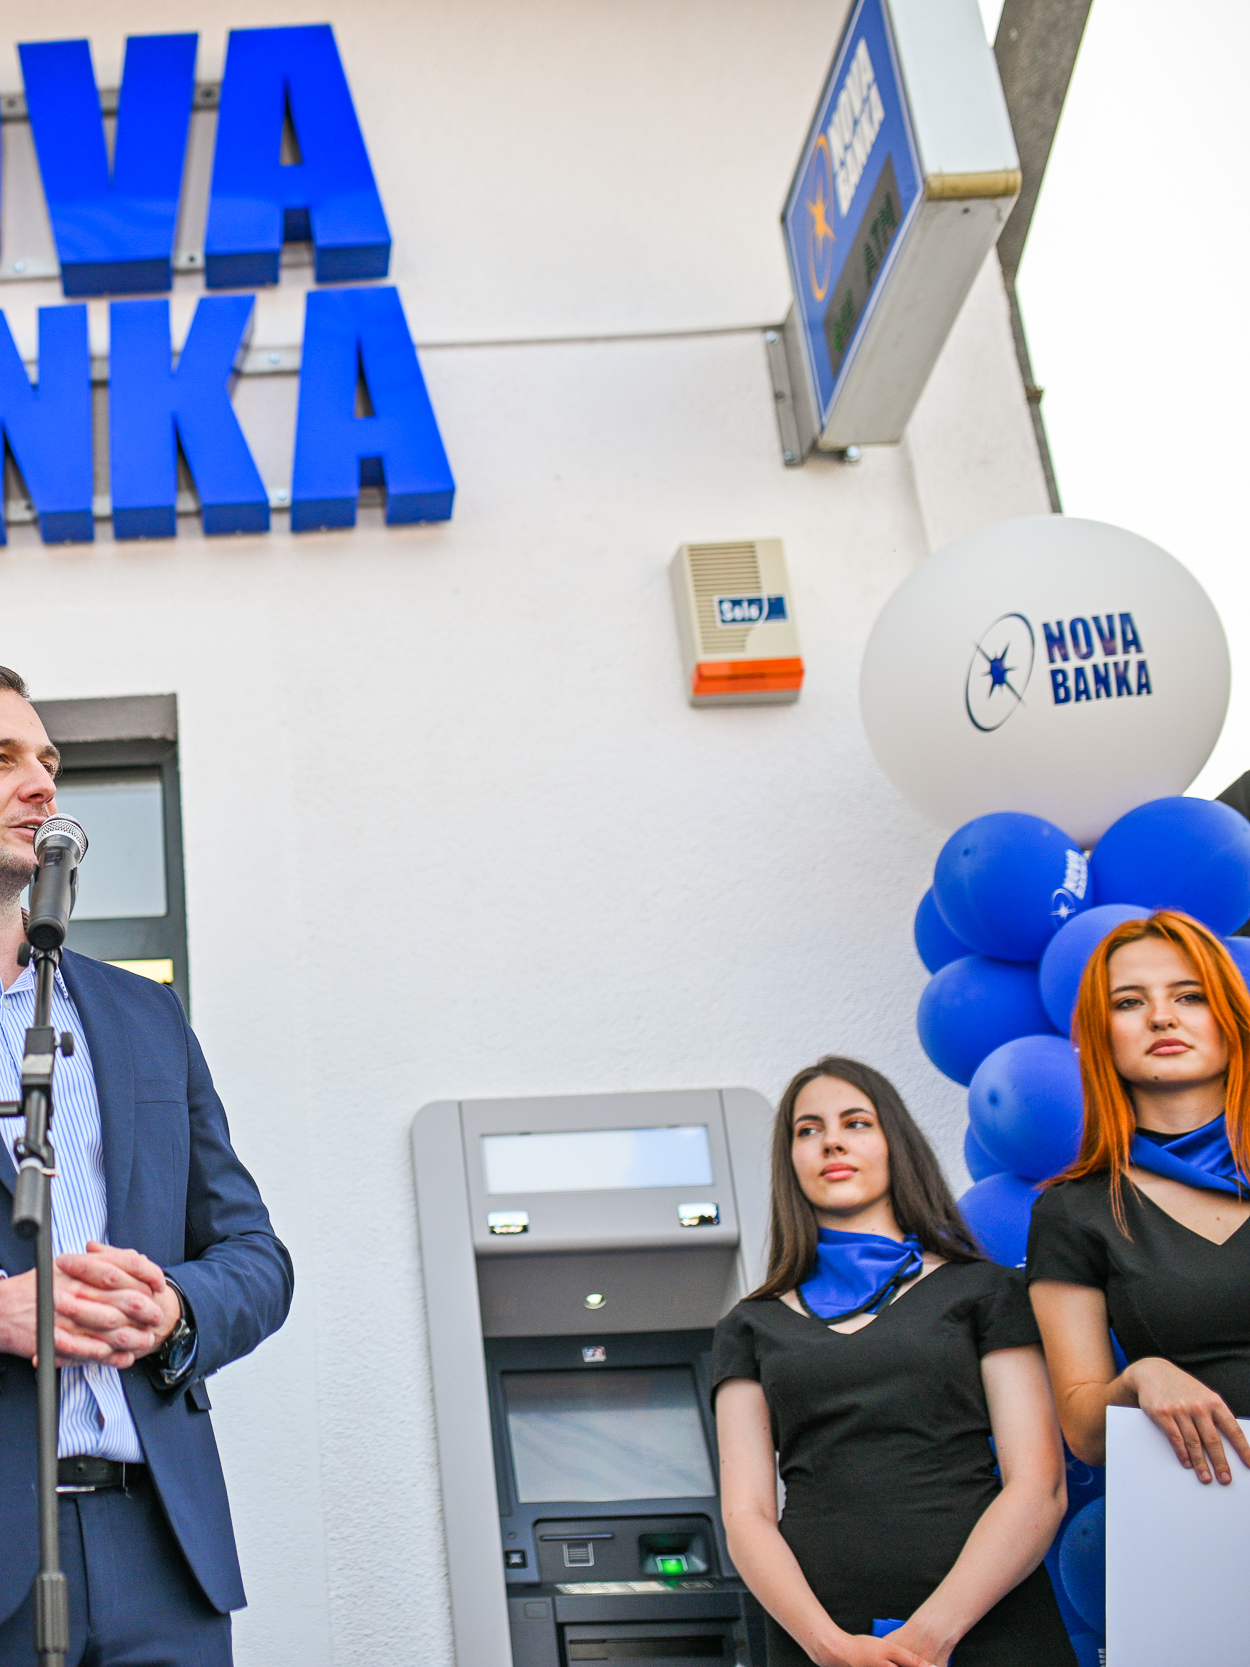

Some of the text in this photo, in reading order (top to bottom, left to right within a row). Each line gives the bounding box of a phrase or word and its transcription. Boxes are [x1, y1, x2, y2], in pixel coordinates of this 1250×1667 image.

[826, 36, 876, 175] NOVA
[721, 600, 760, 622] Solo
[1042, 613, 1143, 663] NOVA
[1050, 660, 1152, 705] BANKA
